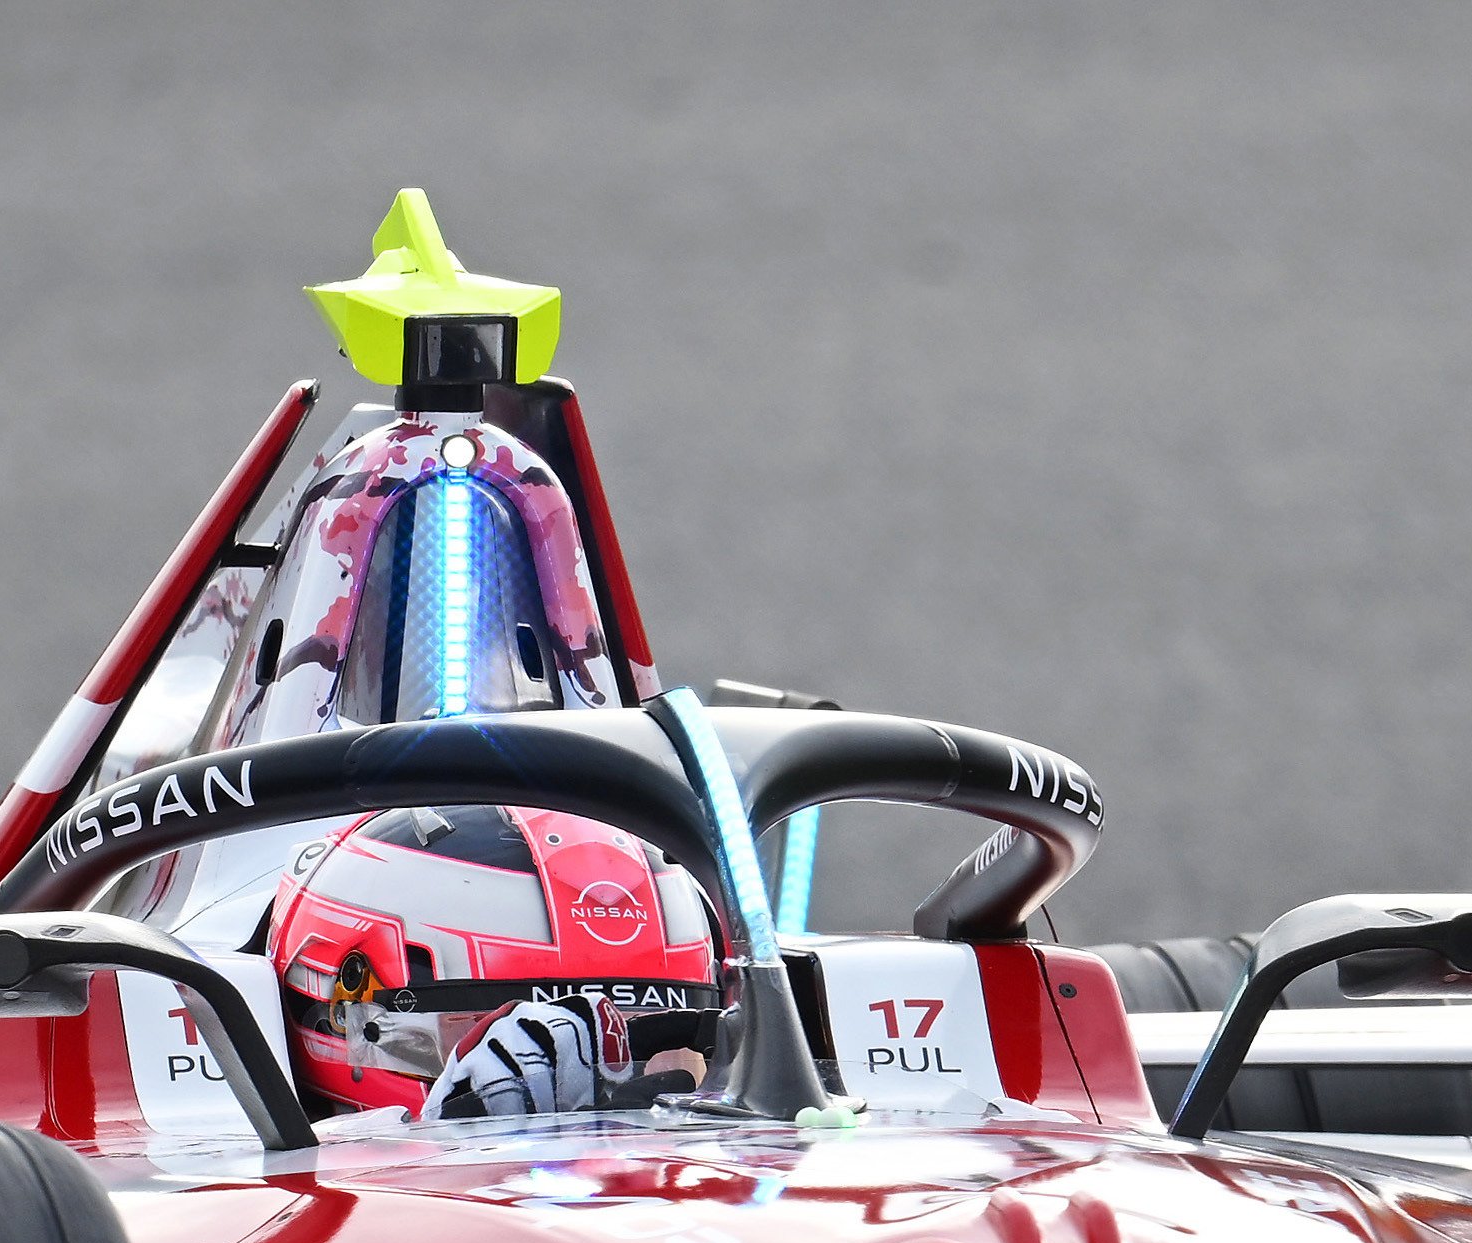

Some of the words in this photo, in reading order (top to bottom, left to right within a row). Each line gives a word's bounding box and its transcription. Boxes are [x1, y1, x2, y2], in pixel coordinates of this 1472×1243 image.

[1006, 745, 1104, 831] NISS
[46, 759, 255, 874] NISSAN
[571, 906, 648, 920] NISSAN
[167, 1007, 199, 1046] 1
[868, 999, 945, 1039] 17
[167, 1054, 227, 1082] PU
[867, 1047, 962, 1074] PUL
